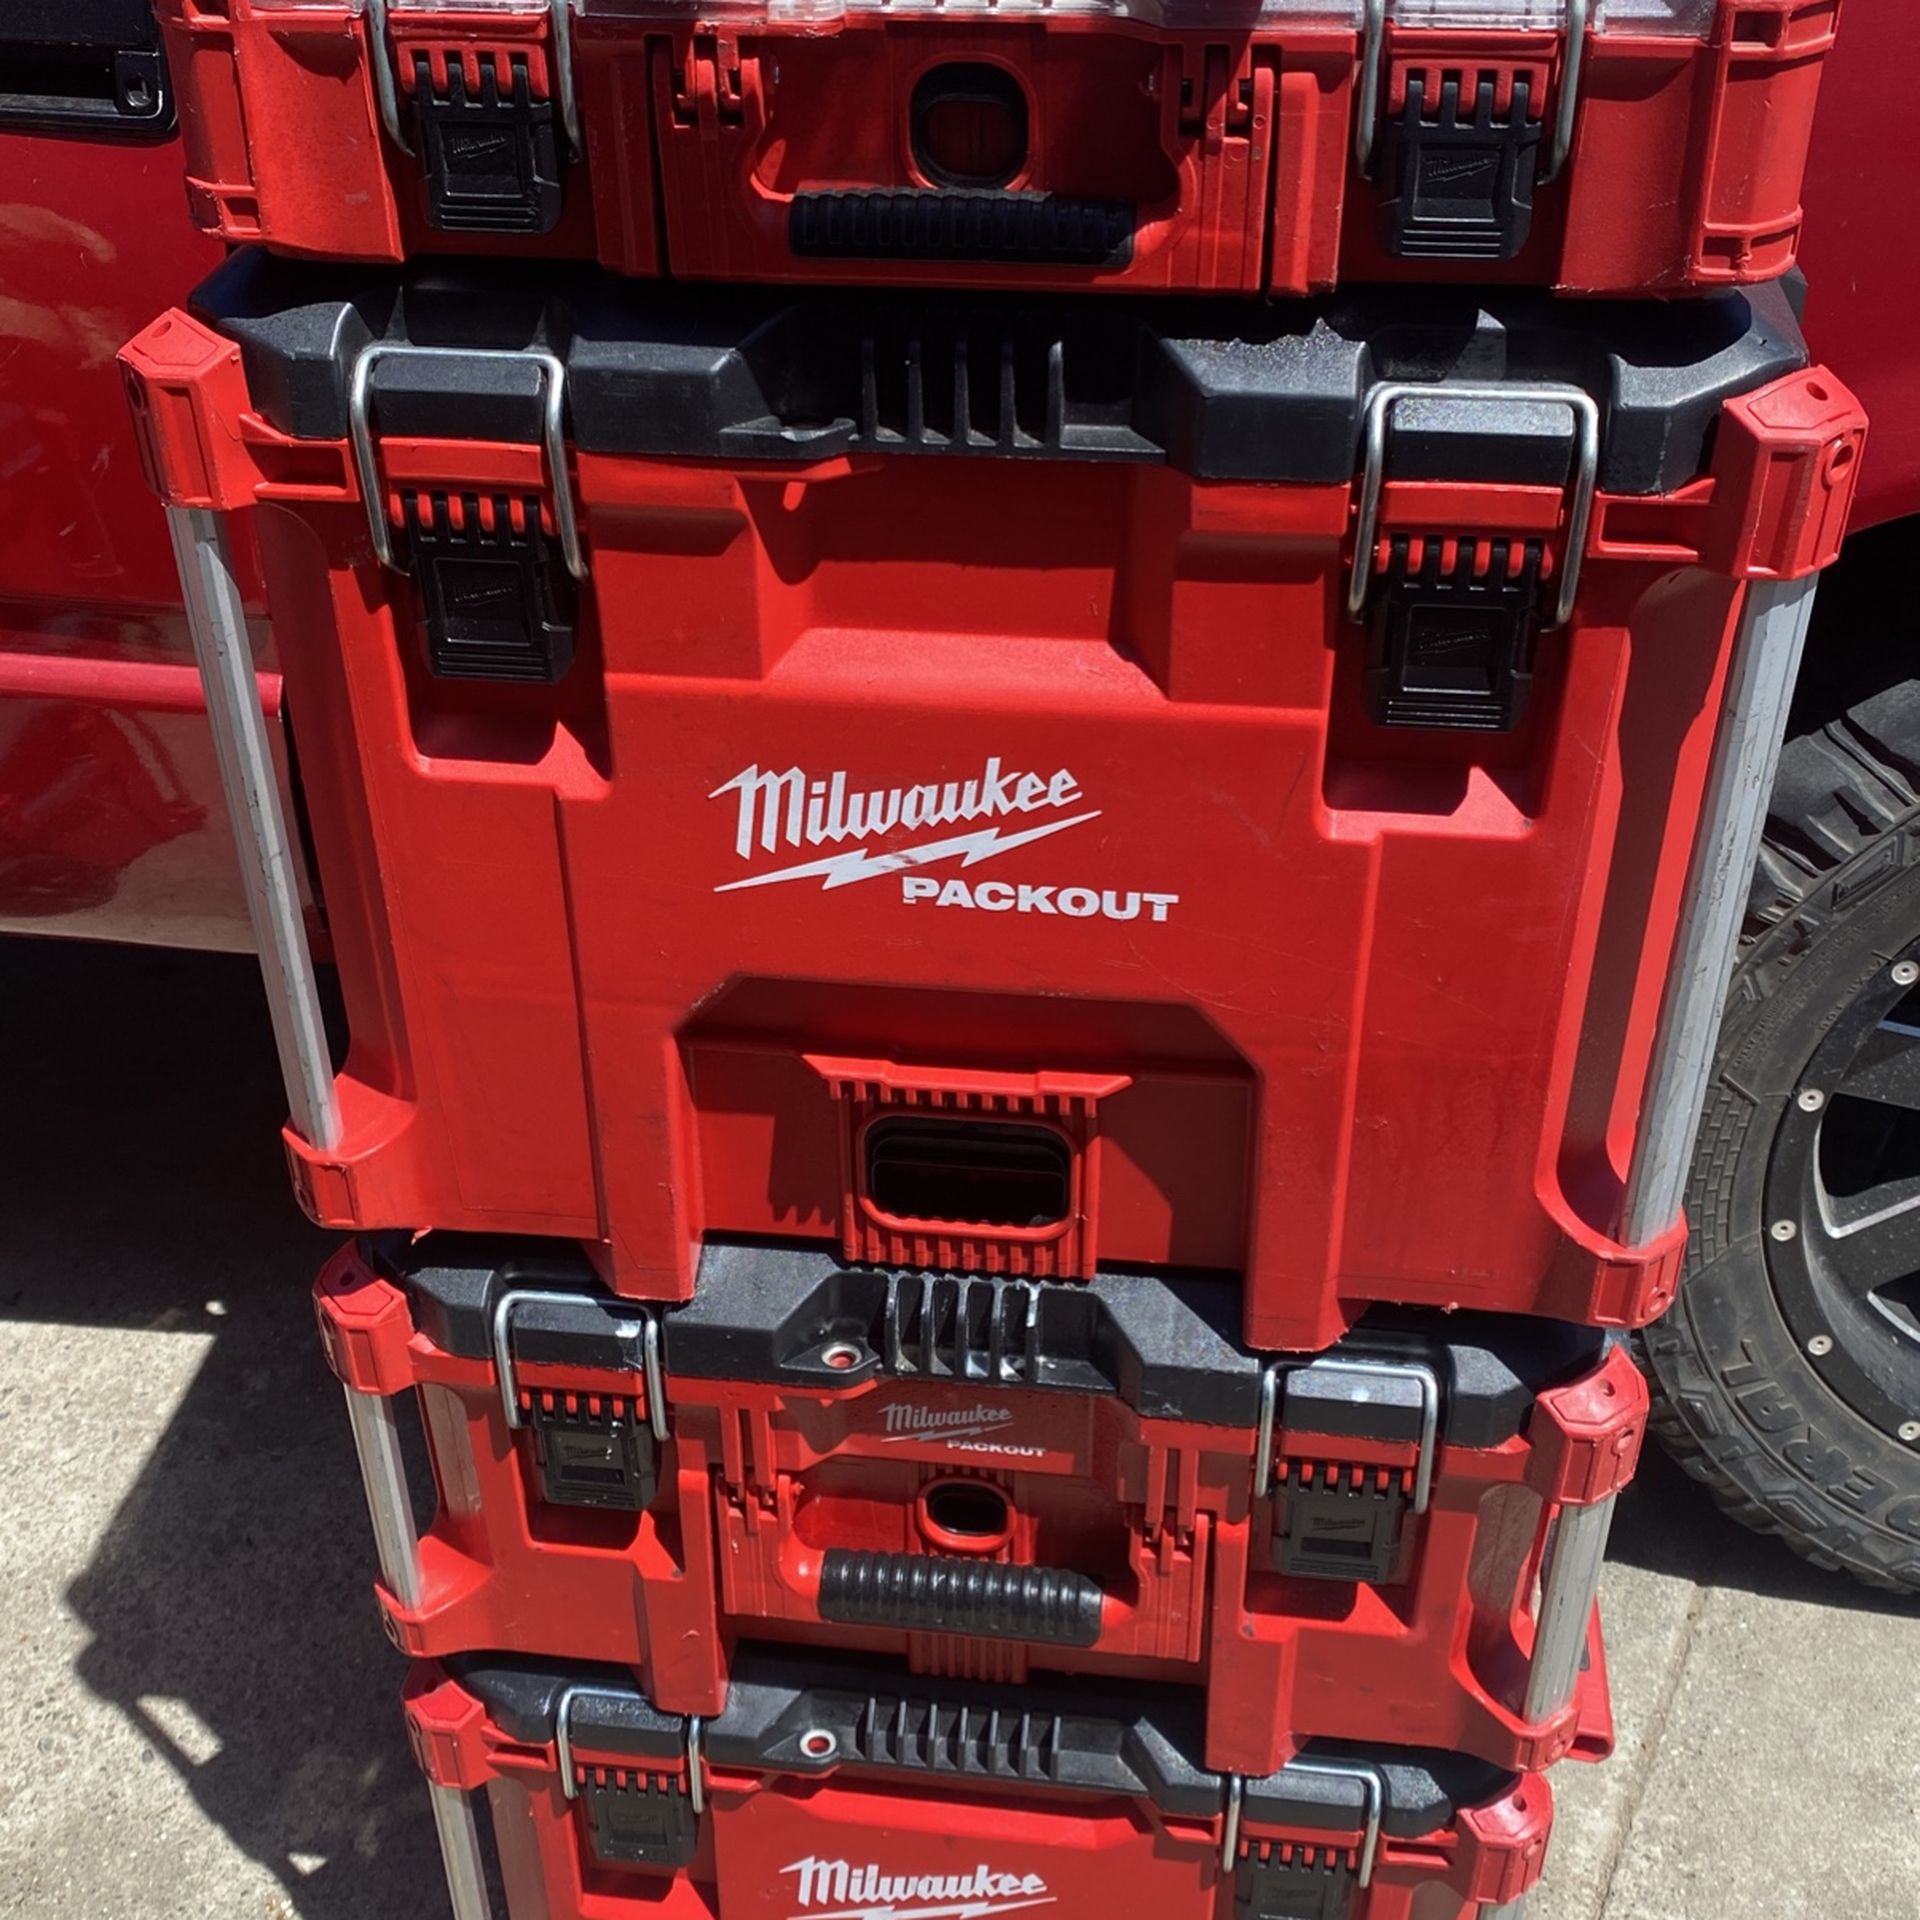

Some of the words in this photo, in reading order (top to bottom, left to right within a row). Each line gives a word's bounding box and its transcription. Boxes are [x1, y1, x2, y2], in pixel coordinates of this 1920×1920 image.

[708, 757, 1083, 860] Milwaukee
[902, 876, 1179, 921] PACKOUT
[877, 1402, 1014, 1432] Milwaukee
[946, 1439, 1046, 1457] PACKOUT
[778, 1855, 1047, 1907] Milwaukee
